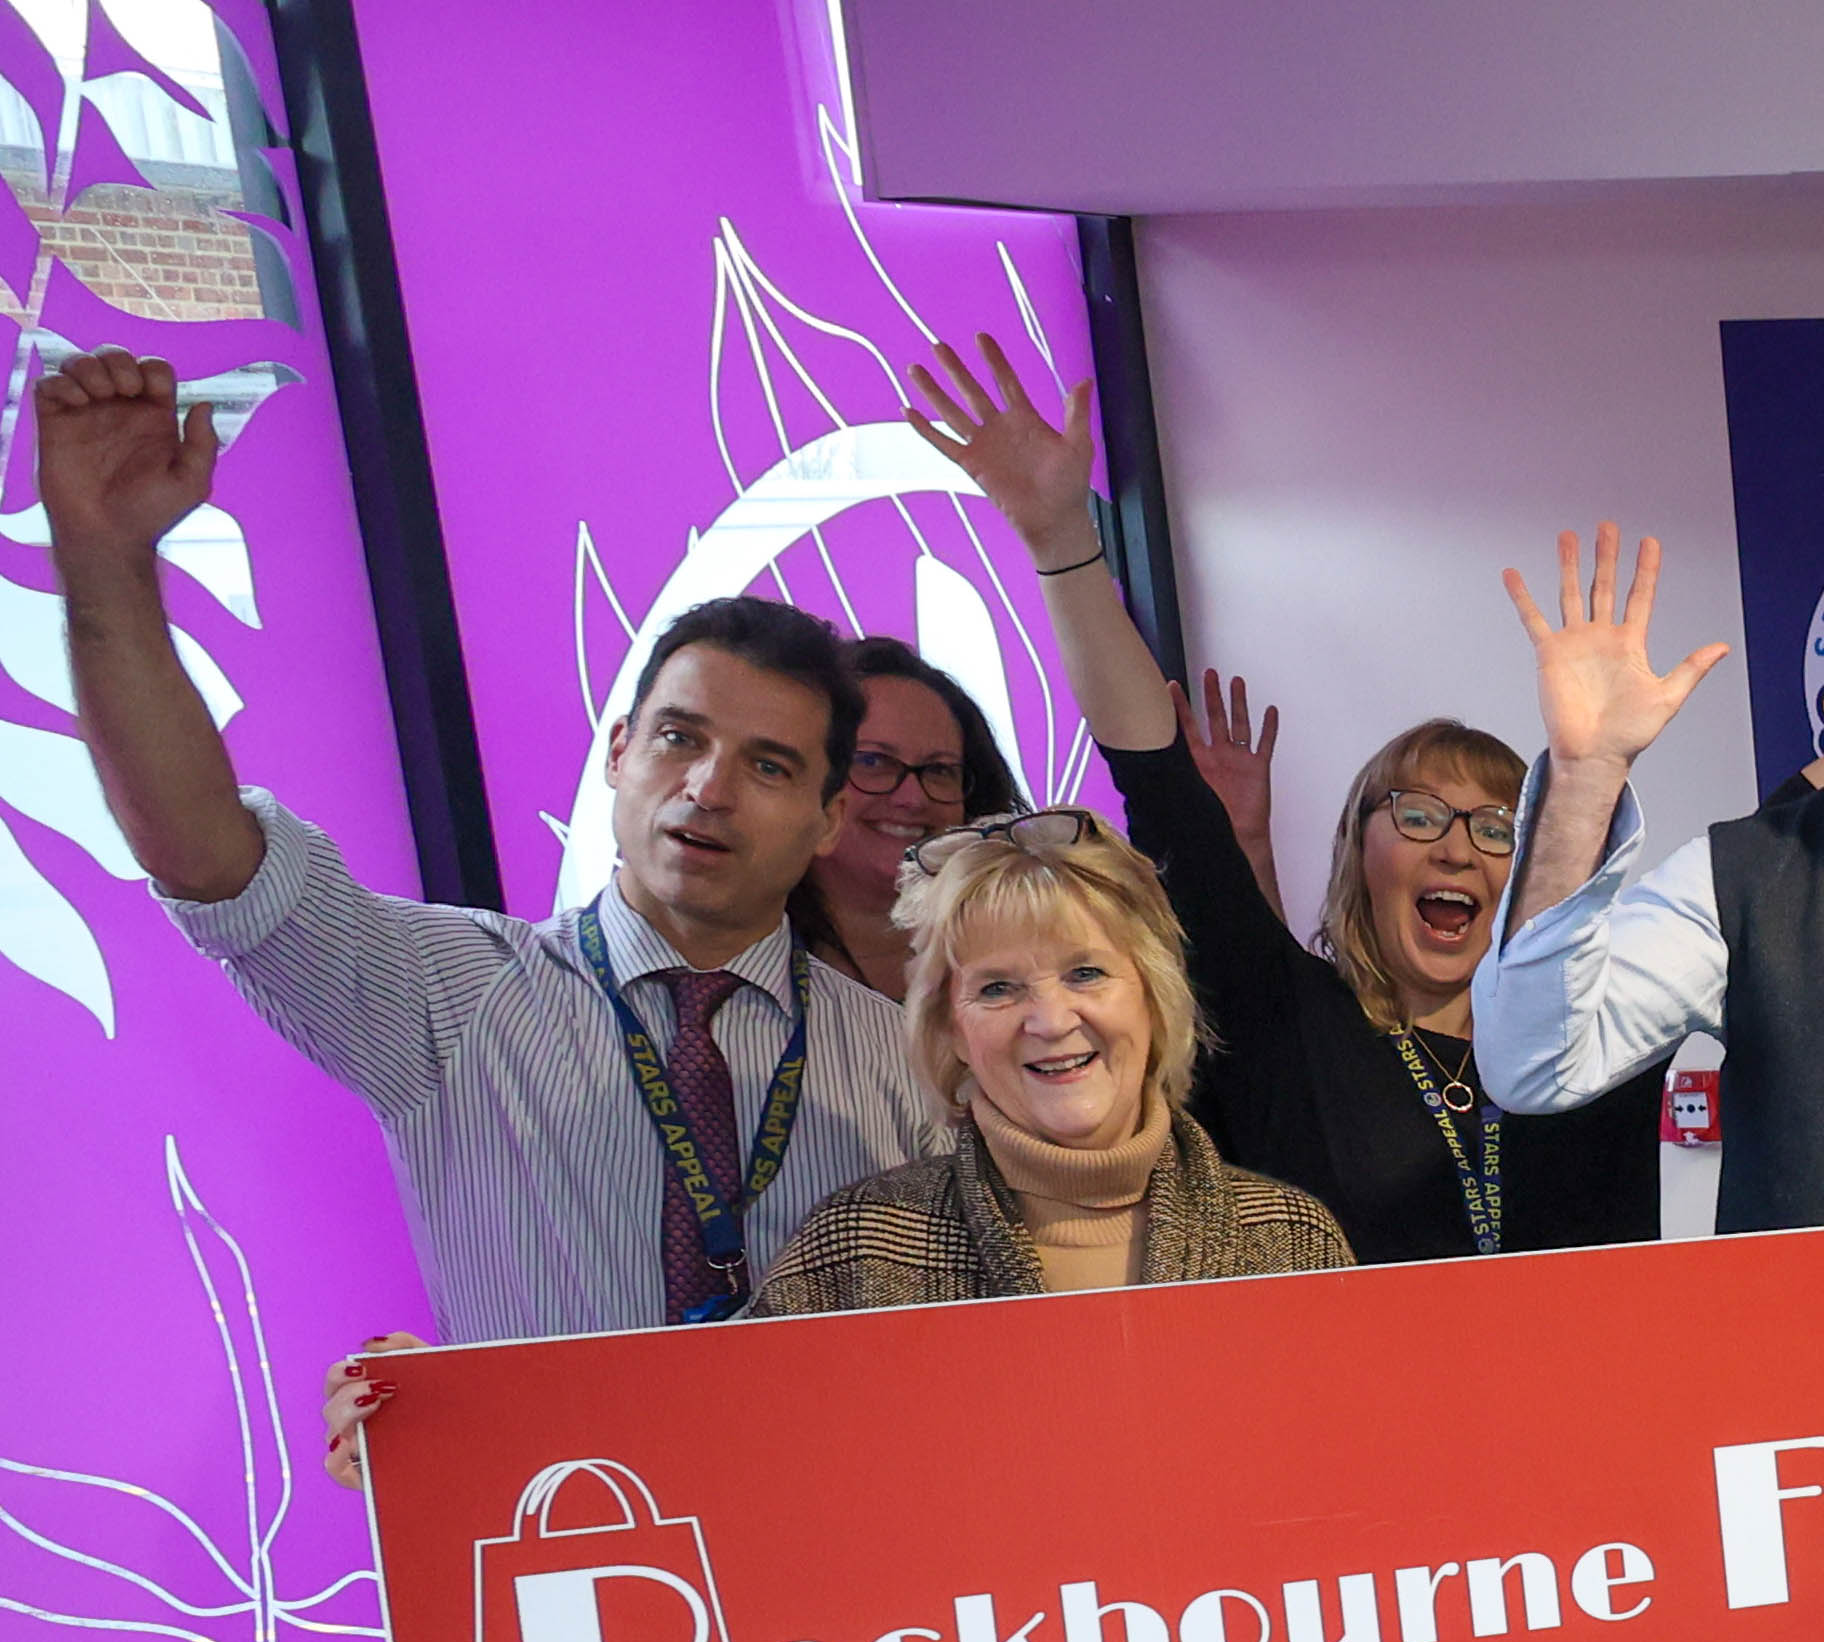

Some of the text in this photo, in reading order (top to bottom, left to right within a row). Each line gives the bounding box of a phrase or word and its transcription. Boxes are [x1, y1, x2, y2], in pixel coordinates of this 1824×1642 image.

[761, 1056, 806, 1152] APPEAL
[1397, 1039, 1435, 1091] STARS
[627, 1033, 722, 1223] STARS APPEAL
[1433, 1108, 1490, 1236] STARS APPEAL
[1483, 1122, 1500, 1176] STARS
